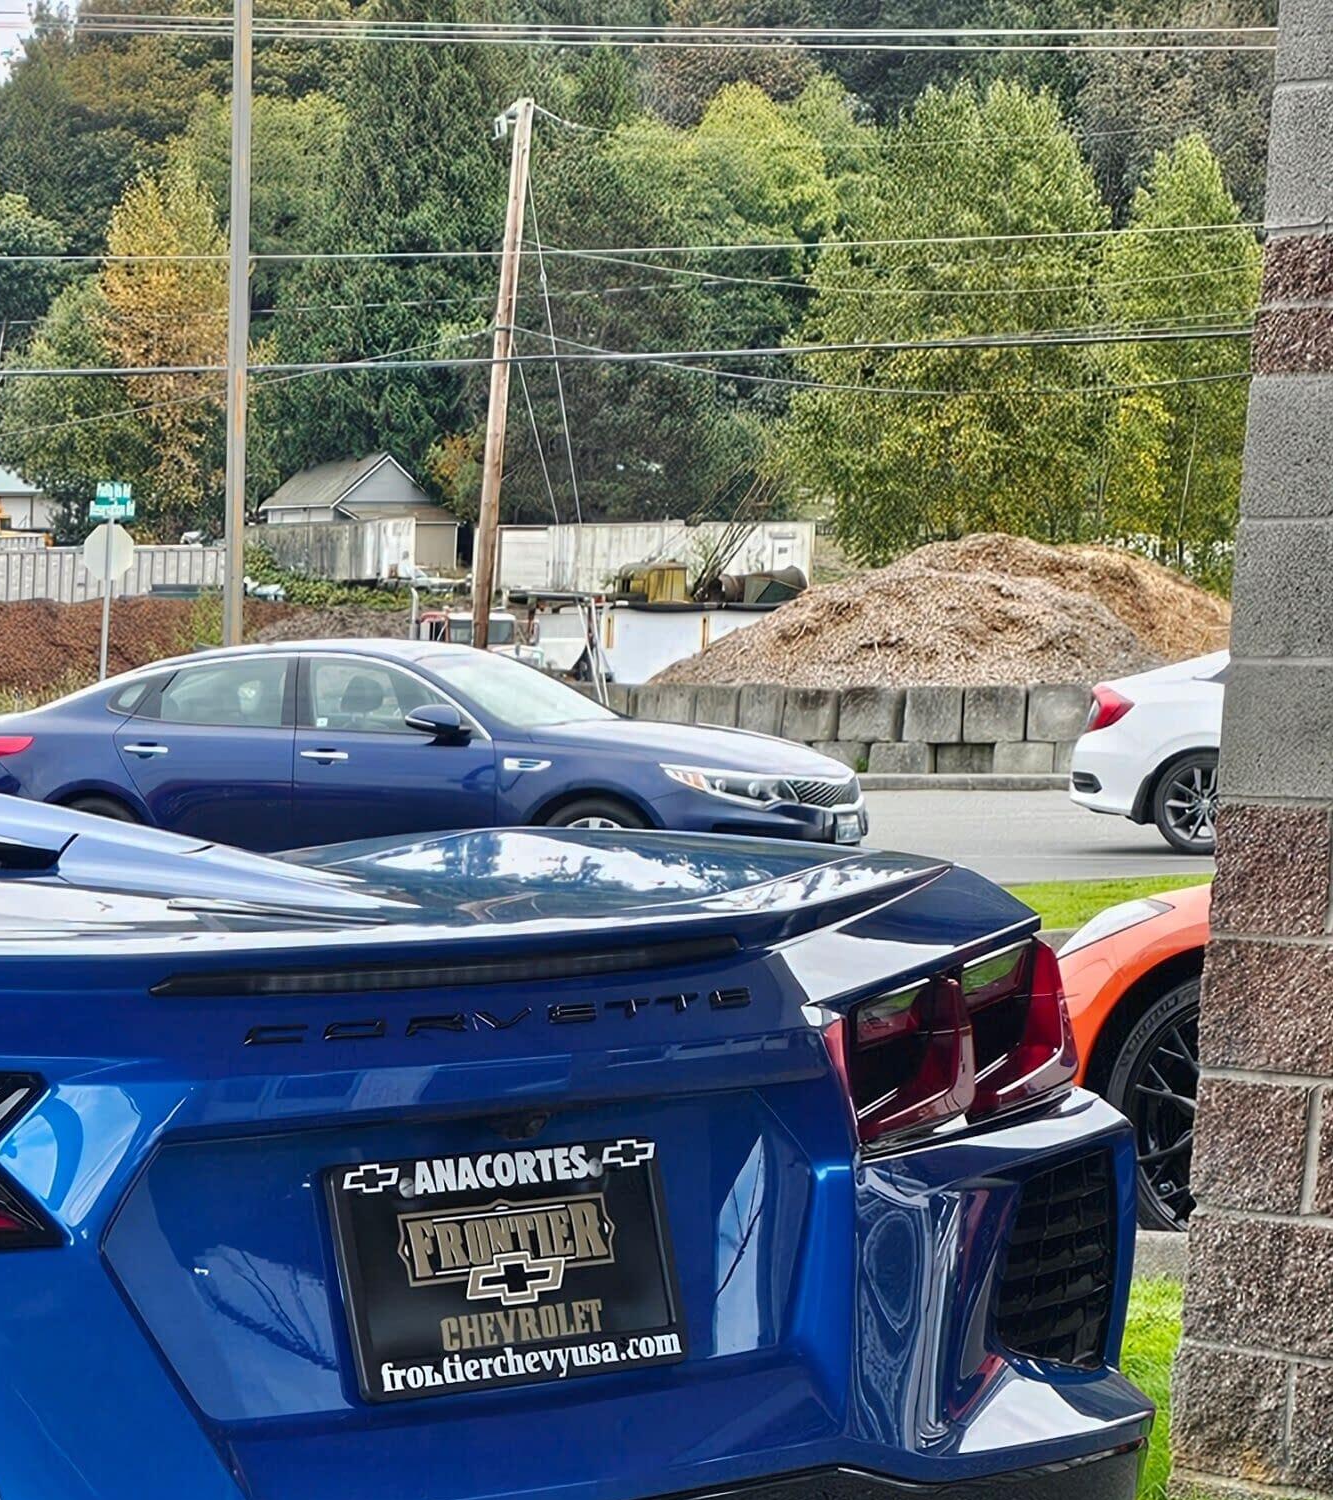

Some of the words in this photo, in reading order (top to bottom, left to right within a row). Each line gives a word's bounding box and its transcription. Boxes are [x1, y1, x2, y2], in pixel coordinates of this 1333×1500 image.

[243, 986, 751, 1046] CORVETTE
[414, 1145, 592, 1196] ANACORTES
[406, 1202, 609, 1278] FRONTIER
[440, 1298, 603, 1351] CHEVROLET
